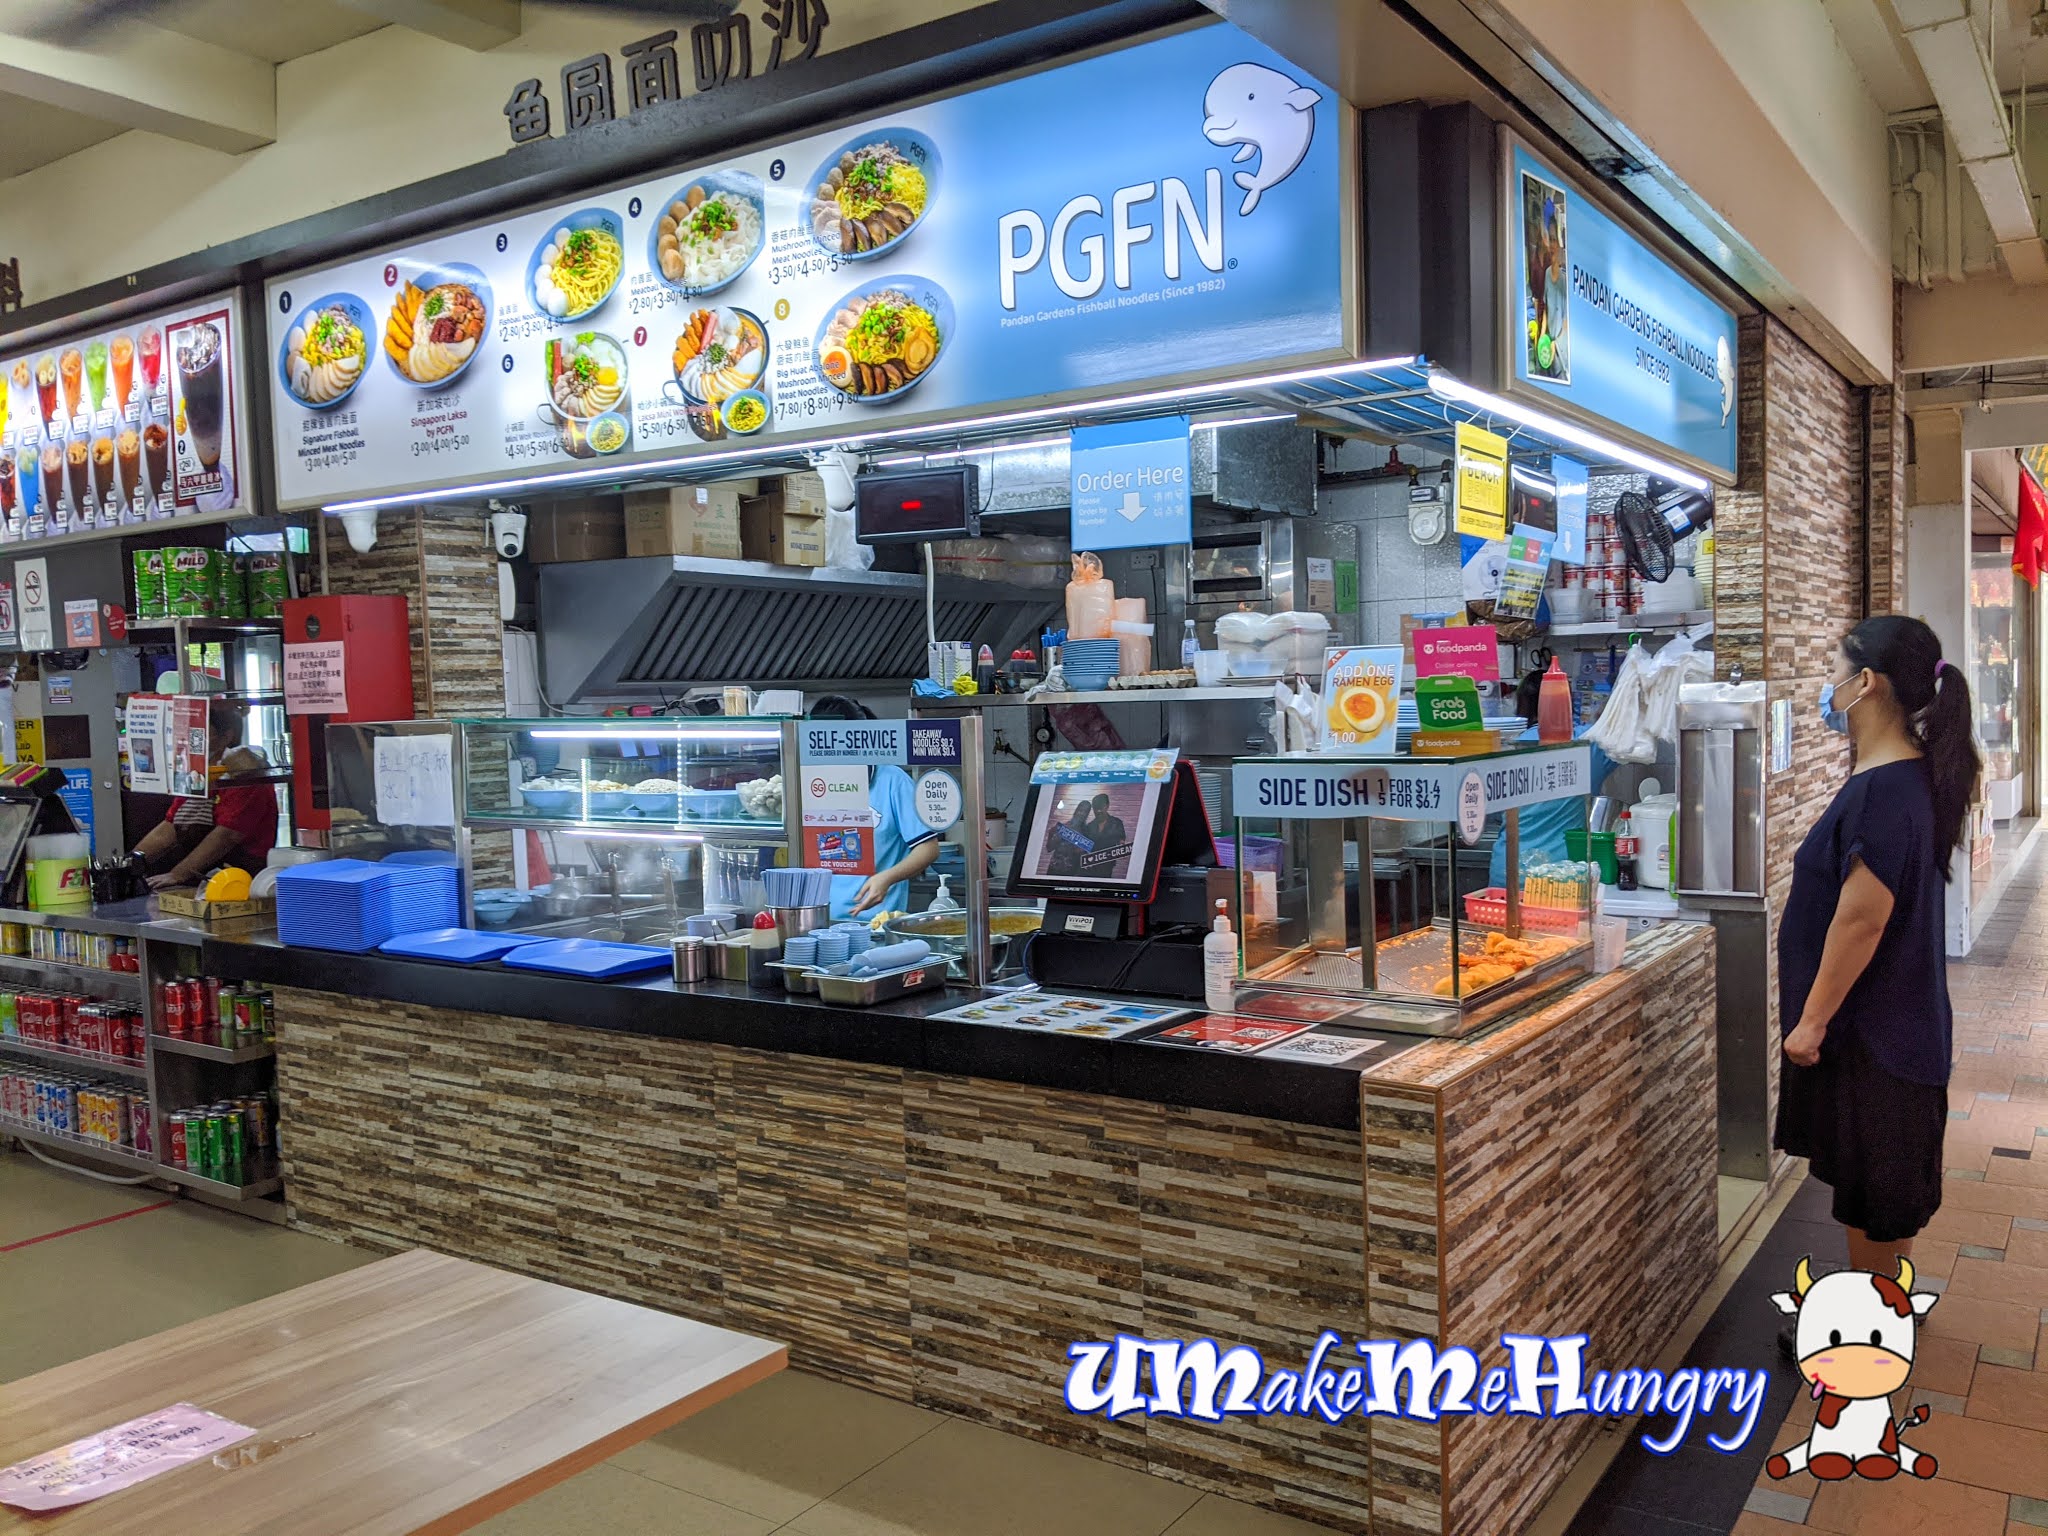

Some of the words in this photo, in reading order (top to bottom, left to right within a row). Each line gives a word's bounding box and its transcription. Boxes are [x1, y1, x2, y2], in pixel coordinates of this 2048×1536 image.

[771, 239, 811, 254] Mushroom
[813, 232, 841, 245] Minced
[998, 166, 1225, 312] PGFN
[772, 255, 791, 265] Meat
[792, 249, 823, 260] Noodles
[631, 284, 659, 295] Meatball
[1000, 314, 1035, 328] Pandan
[1036, 306, 1075, 322] Gardens
[1076, 299, 1116, 315] Fishball
[1117, 291, 1160, 308] Noodles
[1161, 284, 1195, 301] (Since
[1196, 278, 1225, 294] 1982)
[499, 317, 521, 326] Fishball
[1572, 264, 1612, 314] PANDAN
[1612, 293, 1651, 338] GARDENS
[1651, 315, 1684, 361] FISHBALL
[1685, 341, 1715, 381] NOODLES
[777, 369, 789, 378] Big
[790, 365, 808, 376] Huat
[809, 361, 839, 373] Abalone
[1635, 346, 1655, 376] SINCE
[1656, 359, 1670, 384] 1982
[777, 377, 817, 389] Mushroom
[818, 372, 846, 383] Minced
[777, 391, 797, 401] Meat
[798, 386, 828, 398] Noodles
[411, 415, 446, 428] Singapore
[447, 411, 468, 421] Laksa
[303, 433, 333, 446] Signature
[334, 427, 359, 439] Fishball
[426, 428, 435, 438] by
[436, 424, 455, 435] PGFN
[298, 445, 321, 457] Minced
[322, 444, 338, 453] Meat
[339, 439, 366, 450] Noodles
[1077, 471, 1132, 493] Order
[1137, 466, 1184, 487] Here
[177, 556, 206, 568] MILO
[1437, 643, 1487, 655] foodpanda
[1334, 666, 1363, 678] ADD
[1366, 664, 1396, 677] ONE
[1332, 676, 1370, 688] RAMEN
[1374, 676, 1395, 686] EGG
[1431, 696, 1466, 709] Grab
[1432, 709, 1467, 720] Food
[809, 730, 898, 749] SELF-SERVICE
[912, 729, 942, 739] TAKEAWAY
[912, 738, 940, 748] NOODLES
[940, 738, 954, 748] $0.2
[1425, 739, 1461, 747] foodpanda
[912, 747, 927, 757] MINI
[927, 747, 942, 757] WOK
[942, 747, 956, 757] $0.4
[70, 779, 90, 790] LIFE
[813, 784, 824, 792] SG
[828, 783, 858, 792] CLEAN
[925, 780, 948, 791] Open
[1377, 779, 1384, 793] 1
[1389, 779, 1412, 794] FOR
[1415, 779, 1440, 795] $1.4
[1465, 782, 1479, 792] Open
[1486, 770, 1507, 801] SIDE
[1509, 767, 1529, 797] DISH
[925, 790, 948, 800] Daily
[1259, 778, 1307, 806] SIDE
[1315, 778, 1368, 806] DISH
[1465, 793, 1478, 804] Daily
[1378, 792, 1386, 806] 5
[1390, 794, 1413, 808] FOR
[1415, 794, 1440, 809] $6.7
